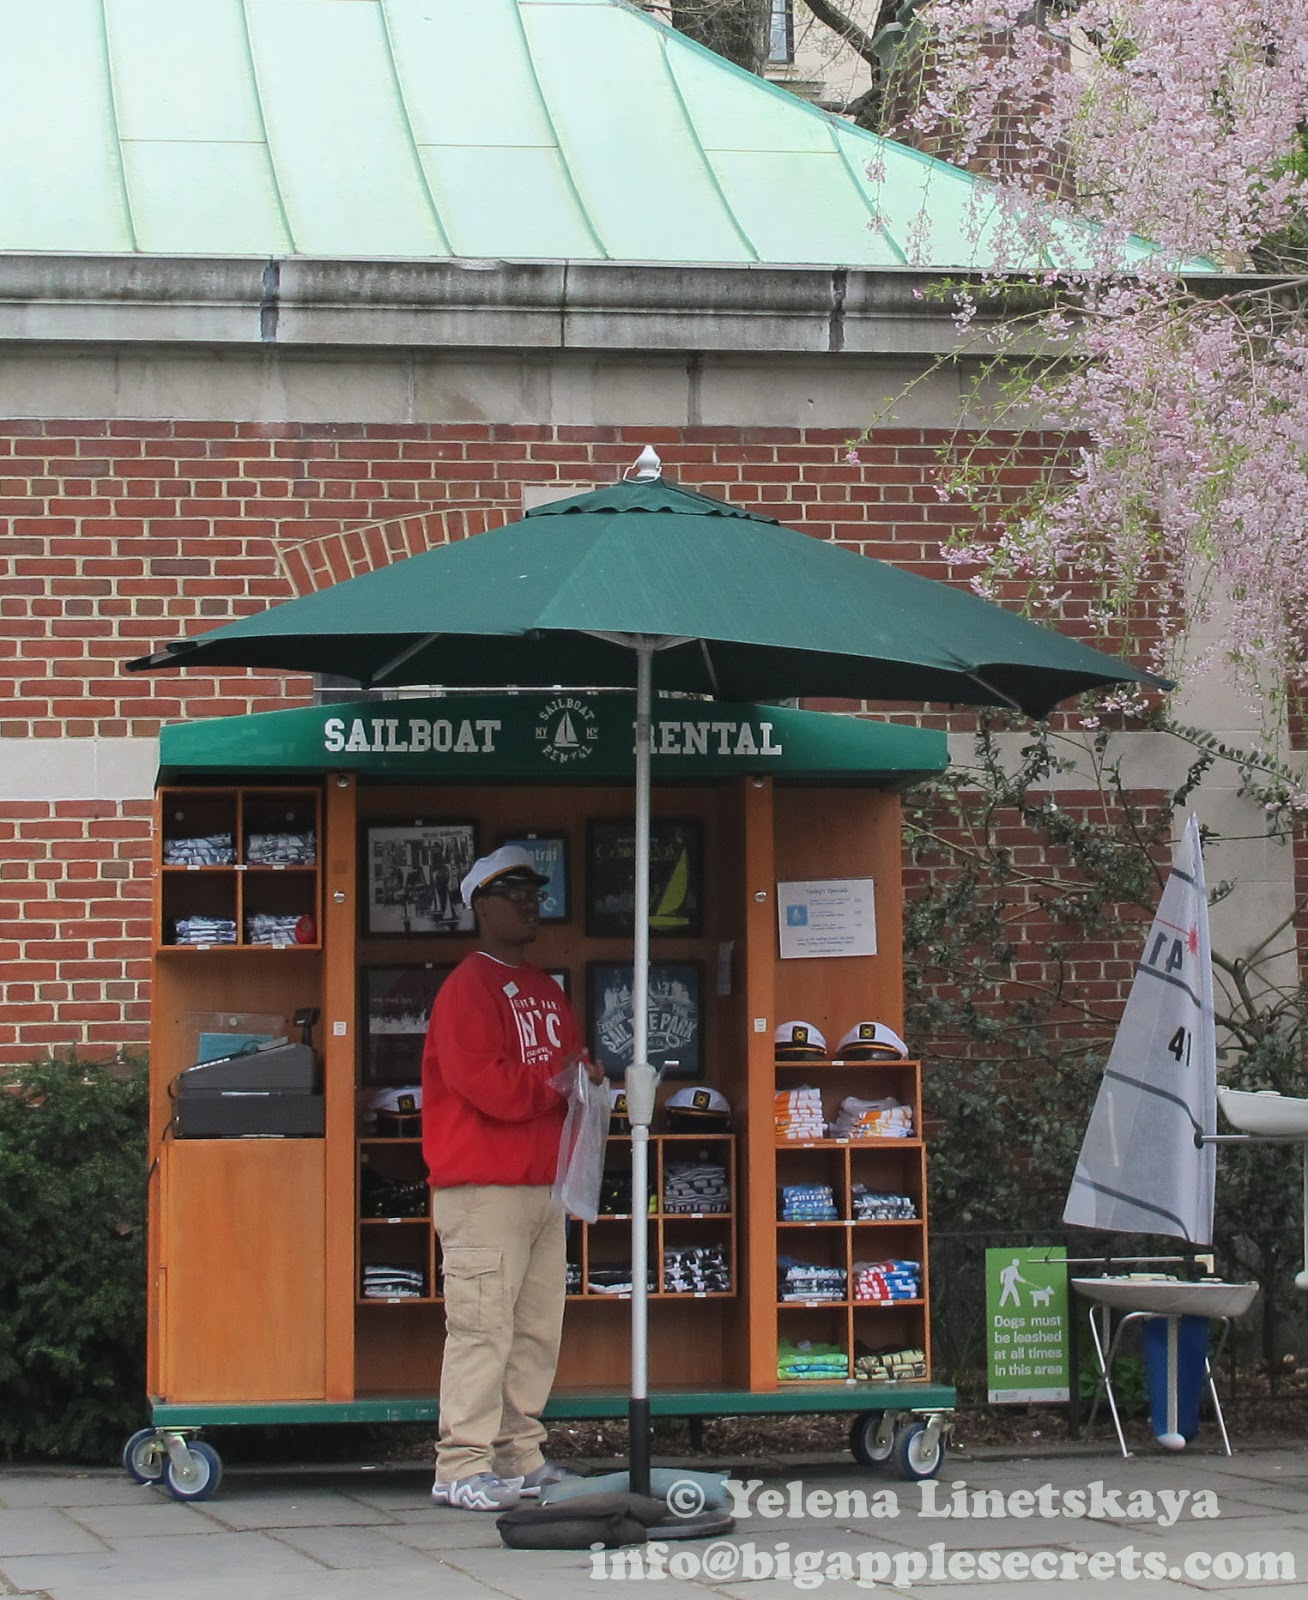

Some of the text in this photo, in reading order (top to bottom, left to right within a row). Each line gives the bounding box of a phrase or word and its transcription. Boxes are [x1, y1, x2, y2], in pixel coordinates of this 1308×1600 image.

[539, 698, 595, 720] SAILBOAT
[324, 718, 502, 753] SAILBOAT
[535, 727, 548, 738] NY
[660, 1012, 697, 1039] PARK
[1168, 1026, 1192, 1066] 41
[994, 1315, 1062, 1329] Dogs must
[994, 1329, 1062, 1343] be leashed
[994, 1346, 1063, 1360] at all times
[995, 1363, 1063, 1376] in this area
